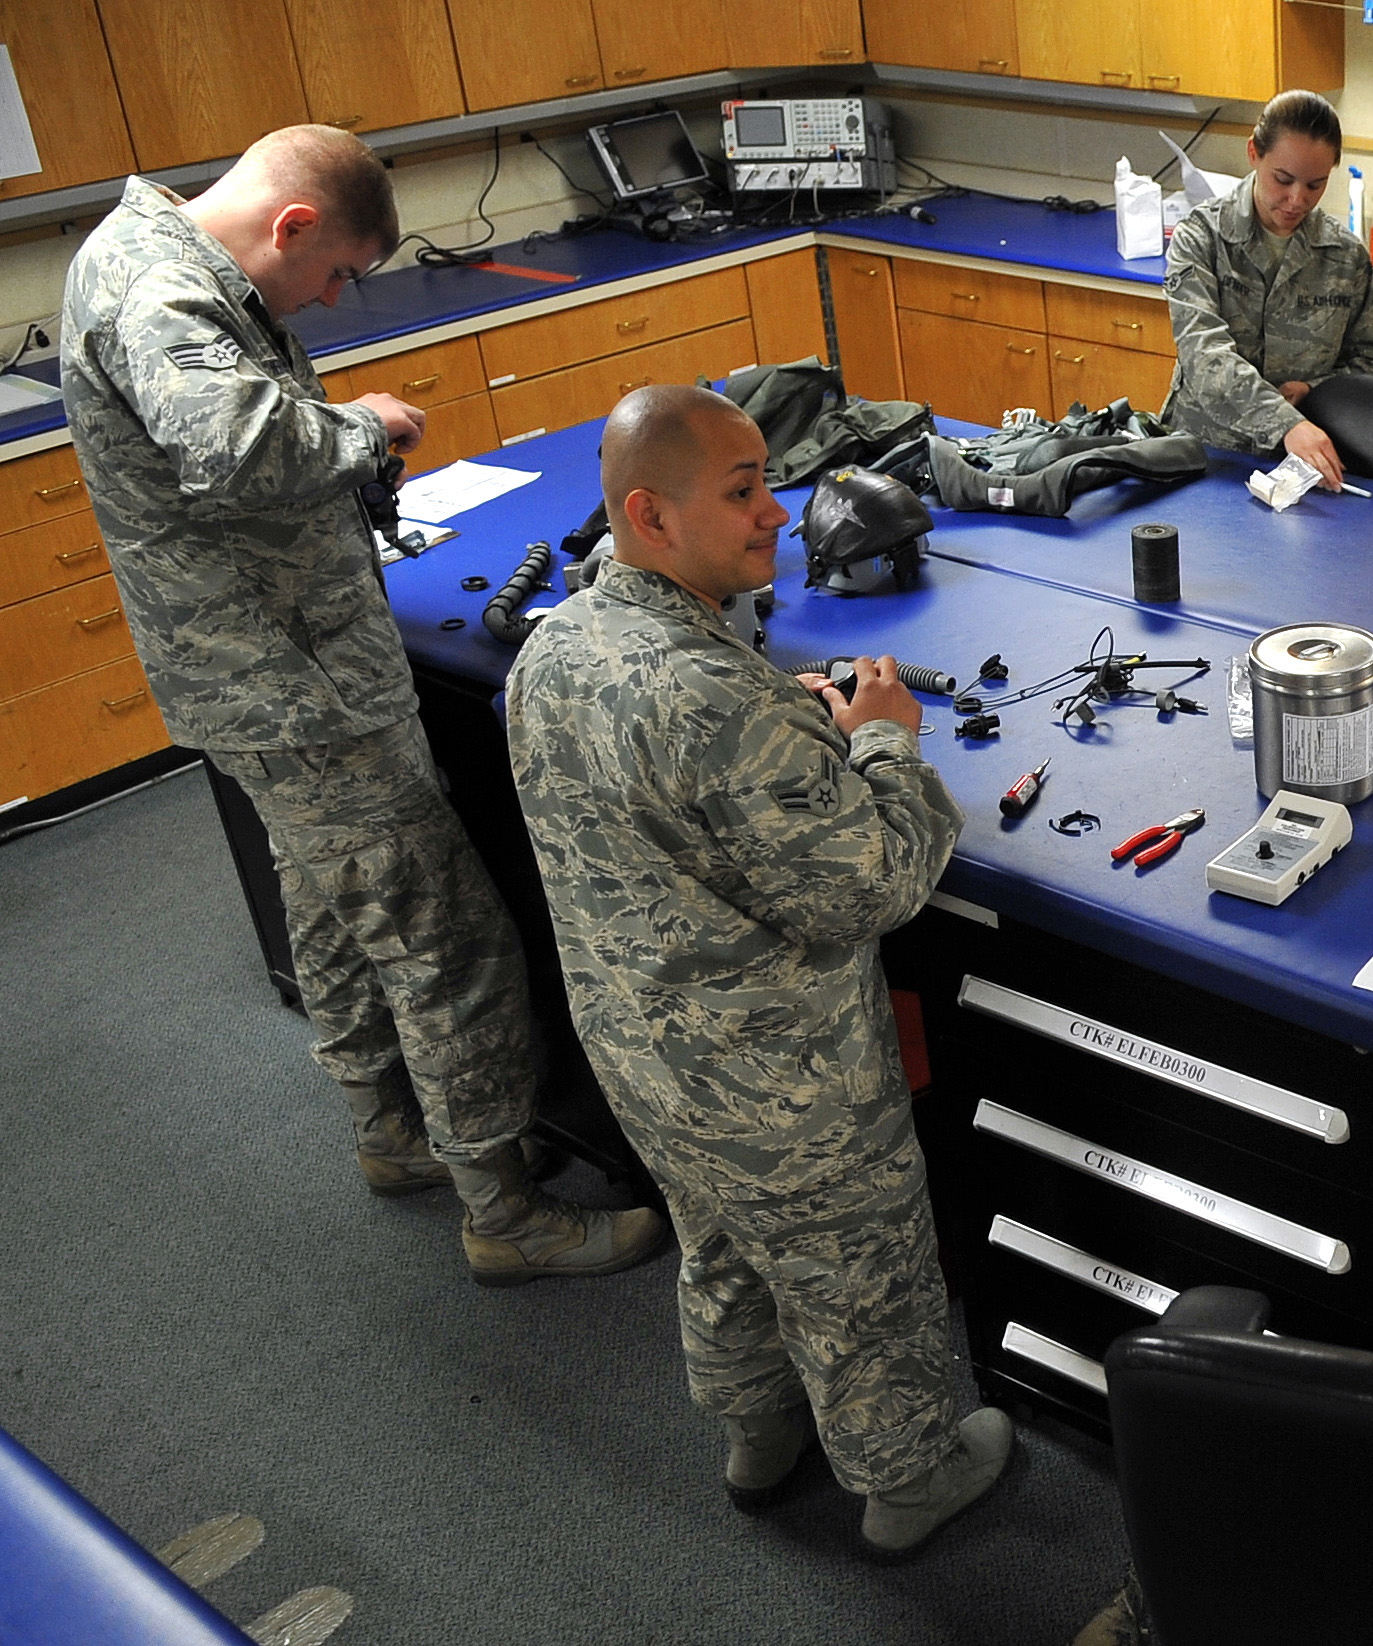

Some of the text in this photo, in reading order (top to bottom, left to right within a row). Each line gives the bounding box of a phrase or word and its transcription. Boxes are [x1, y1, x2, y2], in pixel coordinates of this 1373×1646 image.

[1070, 1021, 1206, 1082] CTK# ELFEB0300
[1084, 1150, 1128, 1177] CTK#
[1092, 1265, 1135, 1294] CTK#
